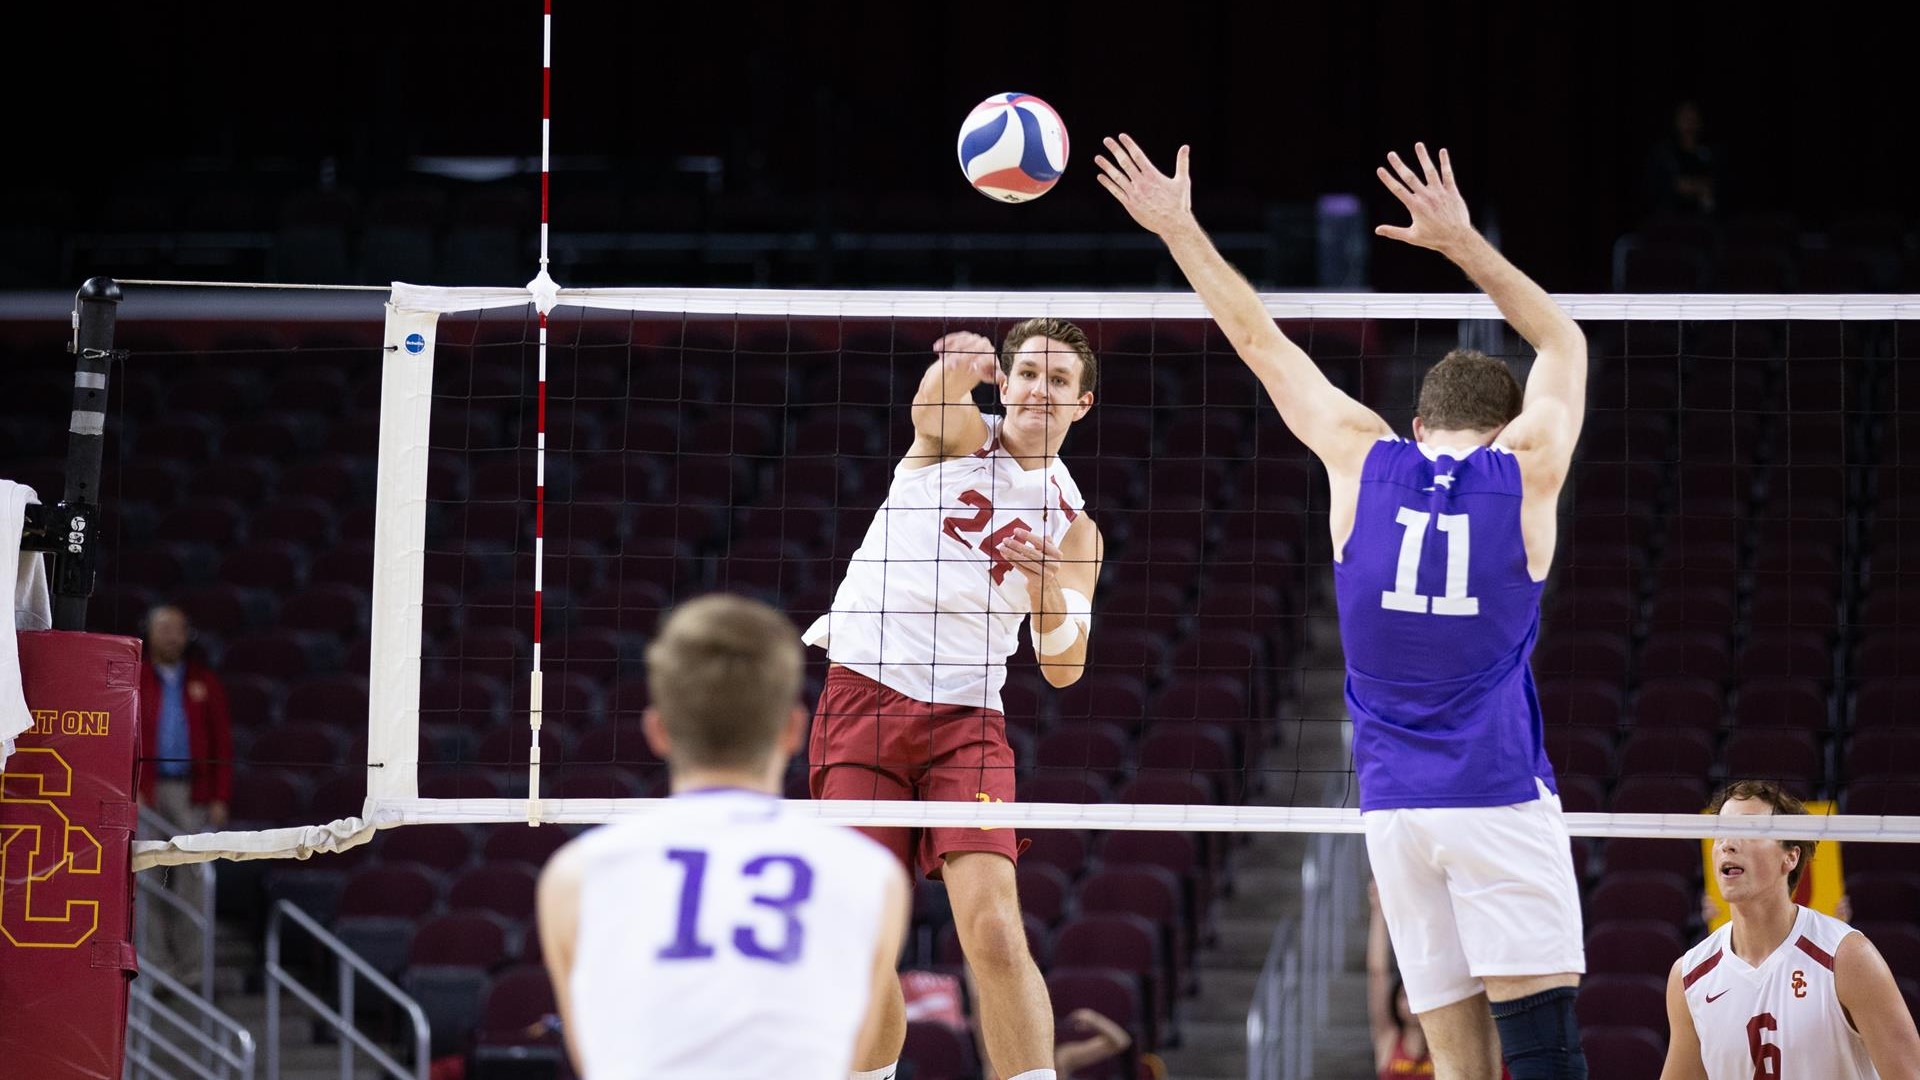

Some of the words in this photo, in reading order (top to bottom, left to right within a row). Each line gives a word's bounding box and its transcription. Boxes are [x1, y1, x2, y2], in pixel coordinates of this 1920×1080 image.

[1381, 506, 1479, 616] 11
[61, 711, 109, 736] ON!
[656, 848, 815, 965] 13
[1791, 970, 1807, 998] SC
[1746, 1012, 1781, 1080] 6
